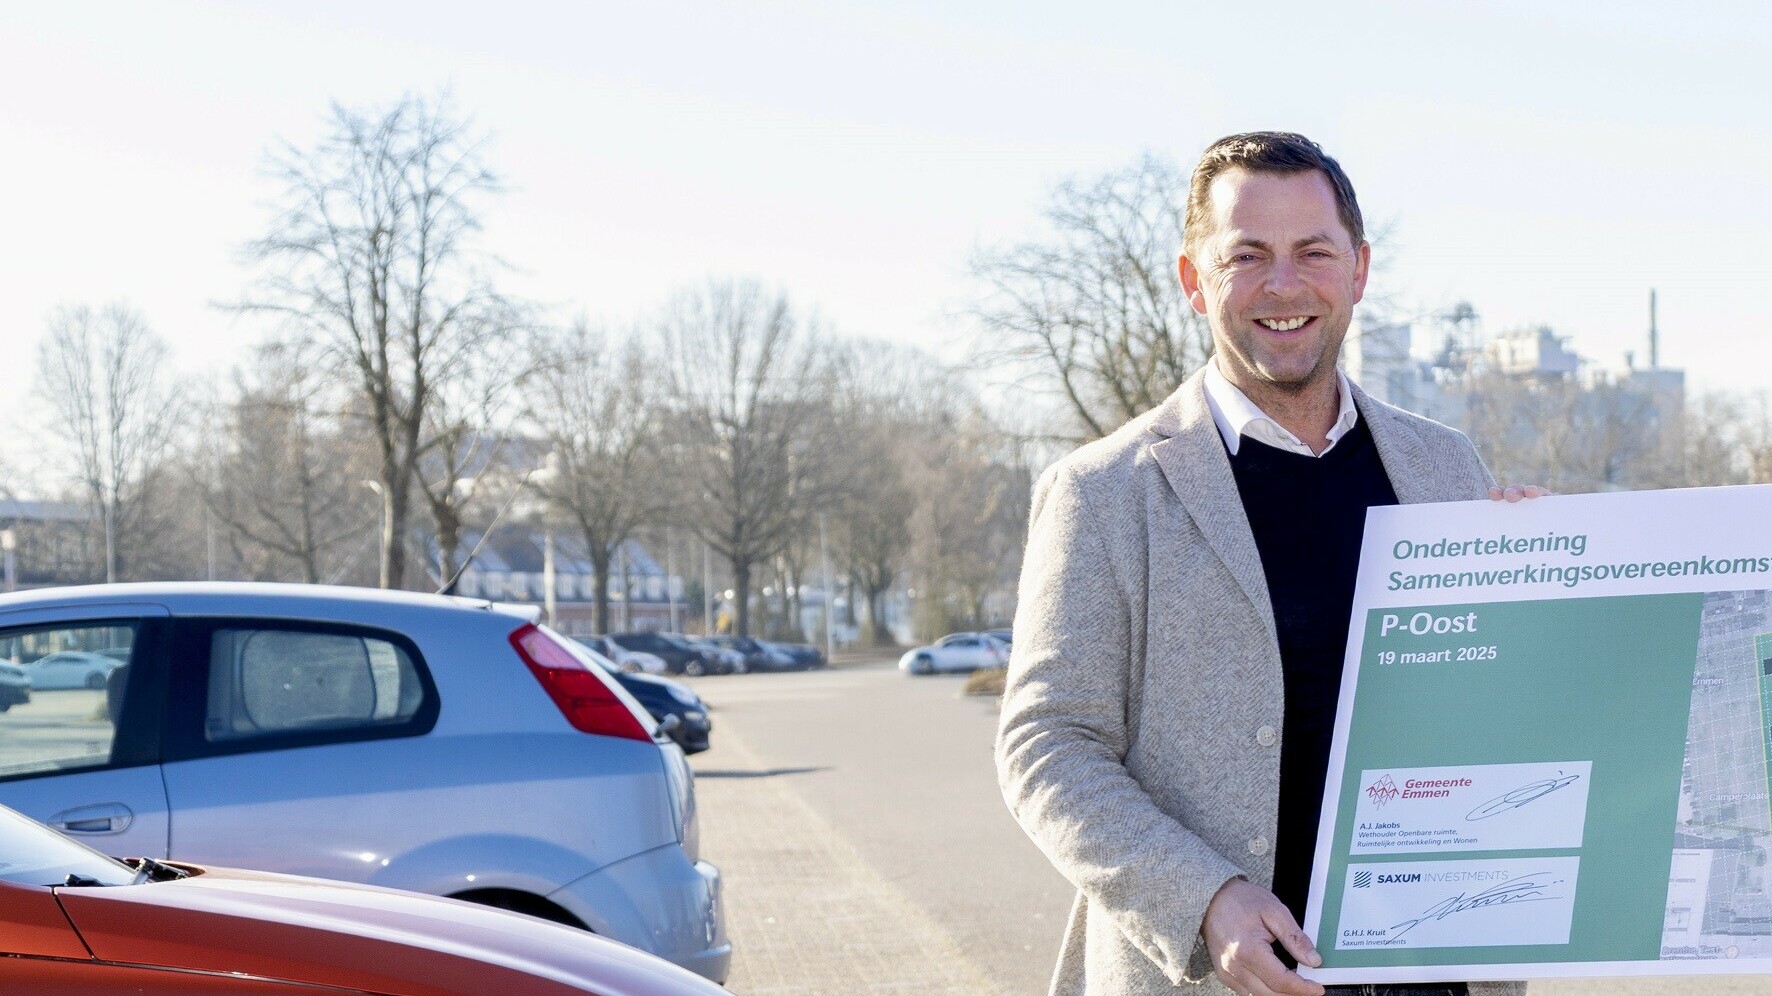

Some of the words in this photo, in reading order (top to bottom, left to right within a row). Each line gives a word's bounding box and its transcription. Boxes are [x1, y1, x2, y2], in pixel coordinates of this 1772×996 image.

[1392, 532, 1588, 560] Ondertekening
[1380, 611, 1478, 637] P-Oost
[1377, 651, 1396, 665] 19
[1400, 648, 1452, 664] maart
[1456, 646, 1498, 661] 2025
[1405, 777, 1472, 789] Gemeente
[1401, 789, 1450, 799] Emmen
[1398, 829, 1432, 837] Openbare
[1357, 839, 1395, 848] Ruimtelijke
[1397, 838, 1441, 847] ontwikkeling
[1377, 873, 1421, 883] SAXUM
[1424, 870, 1509, 882] INVESTMENTS
[1343, 929, 1365, 937] G.H.J.
[1367, 928, 1386, 936] Kruit
[1366, 938, 1407, 946] Investments
